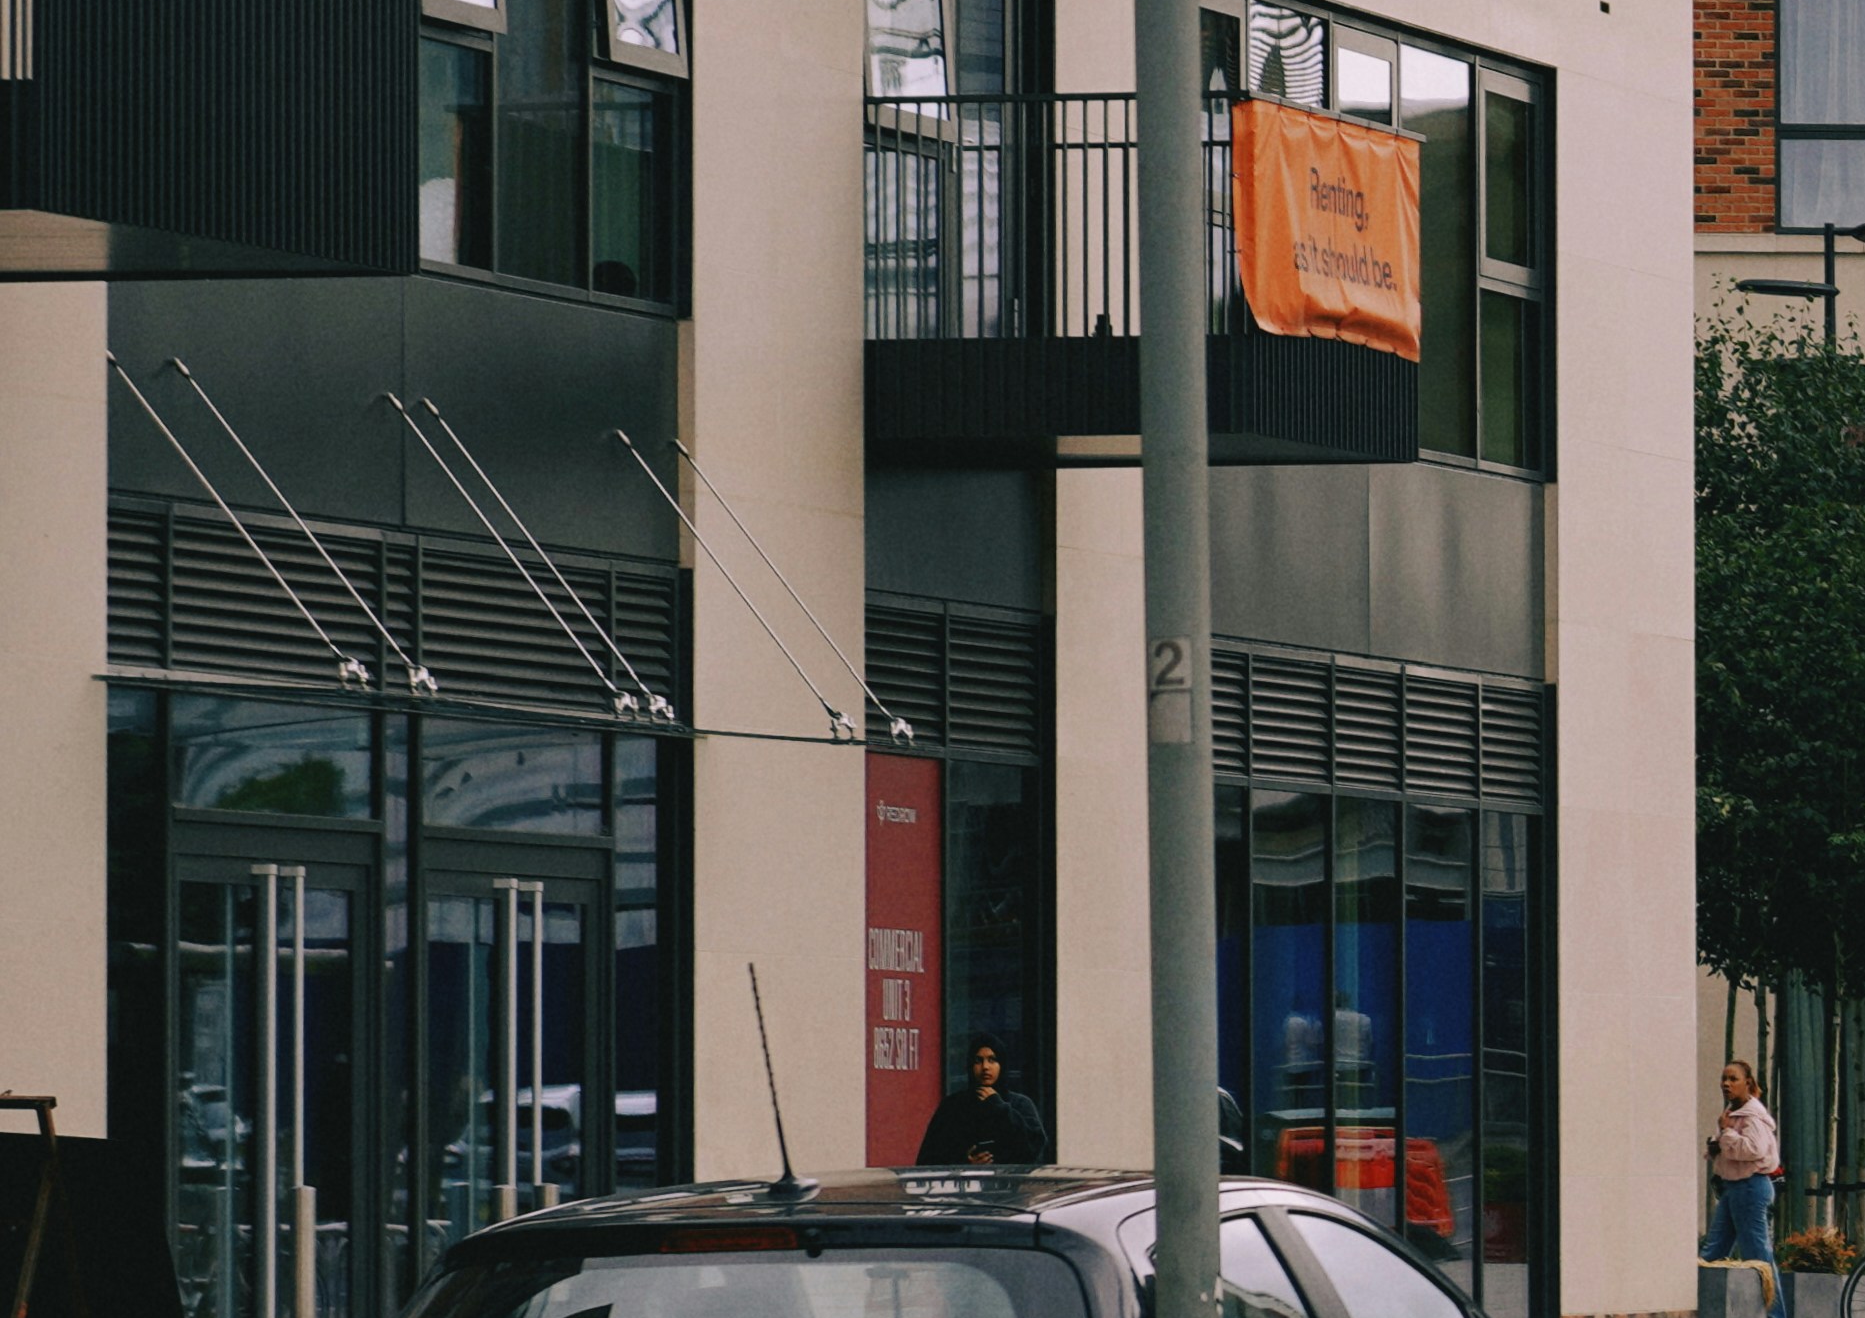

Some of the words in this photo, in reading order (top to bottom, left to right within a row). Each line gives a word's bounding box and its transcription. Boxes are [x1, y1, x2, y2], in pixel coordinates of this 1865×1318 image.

[1310, 167, 1369, 233] Renting,
[1322, 237, 1369, 286] should
[1154, 640, 1185, 686] 2
[868, 928, 925, 973] COMMERCIAL
[904, 979, 911, 1021] 3
